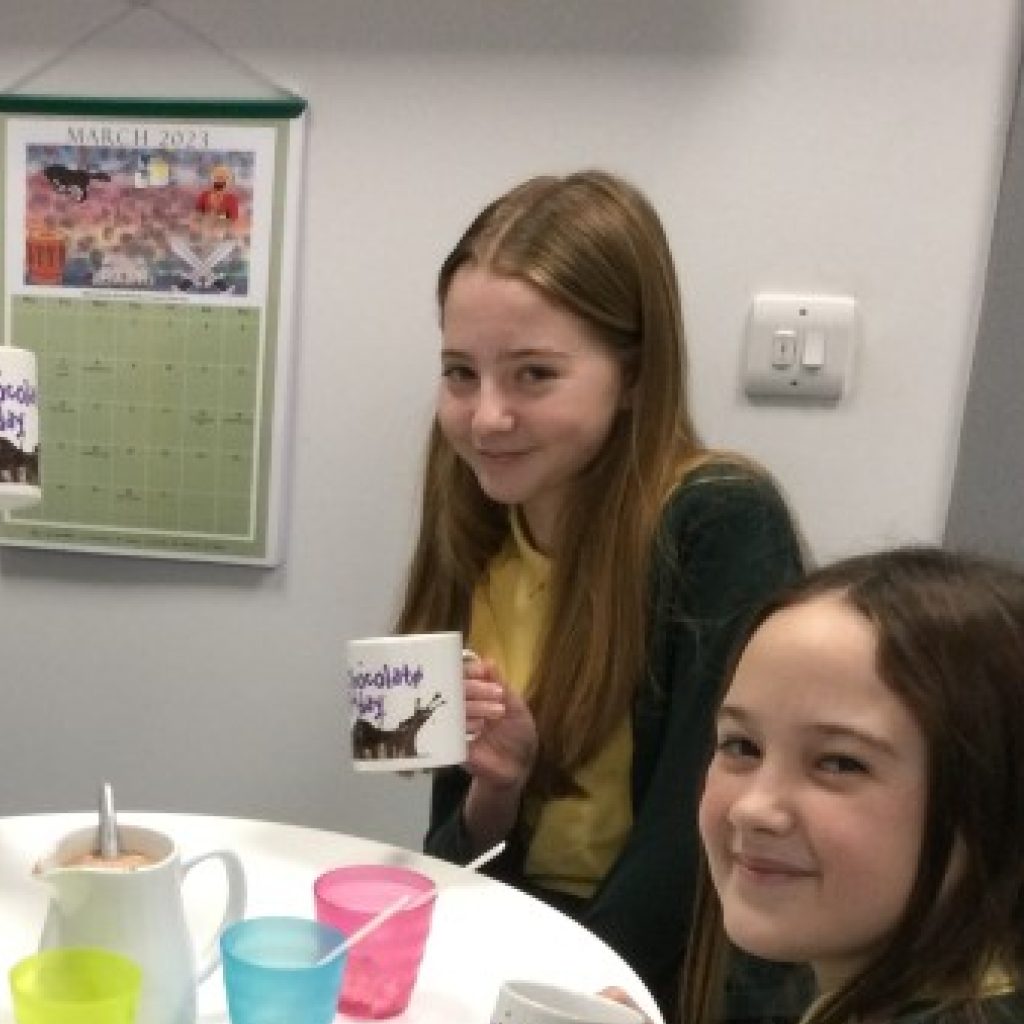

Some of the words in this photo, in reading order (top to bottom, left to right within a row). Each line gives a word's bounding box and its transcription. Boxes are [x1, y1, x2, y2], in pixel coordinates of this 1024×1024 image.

[68, 126, 148, 147] MARCH
[158, 129, 209, 148] 2023
[347, 664, 424, 690] hocolate
